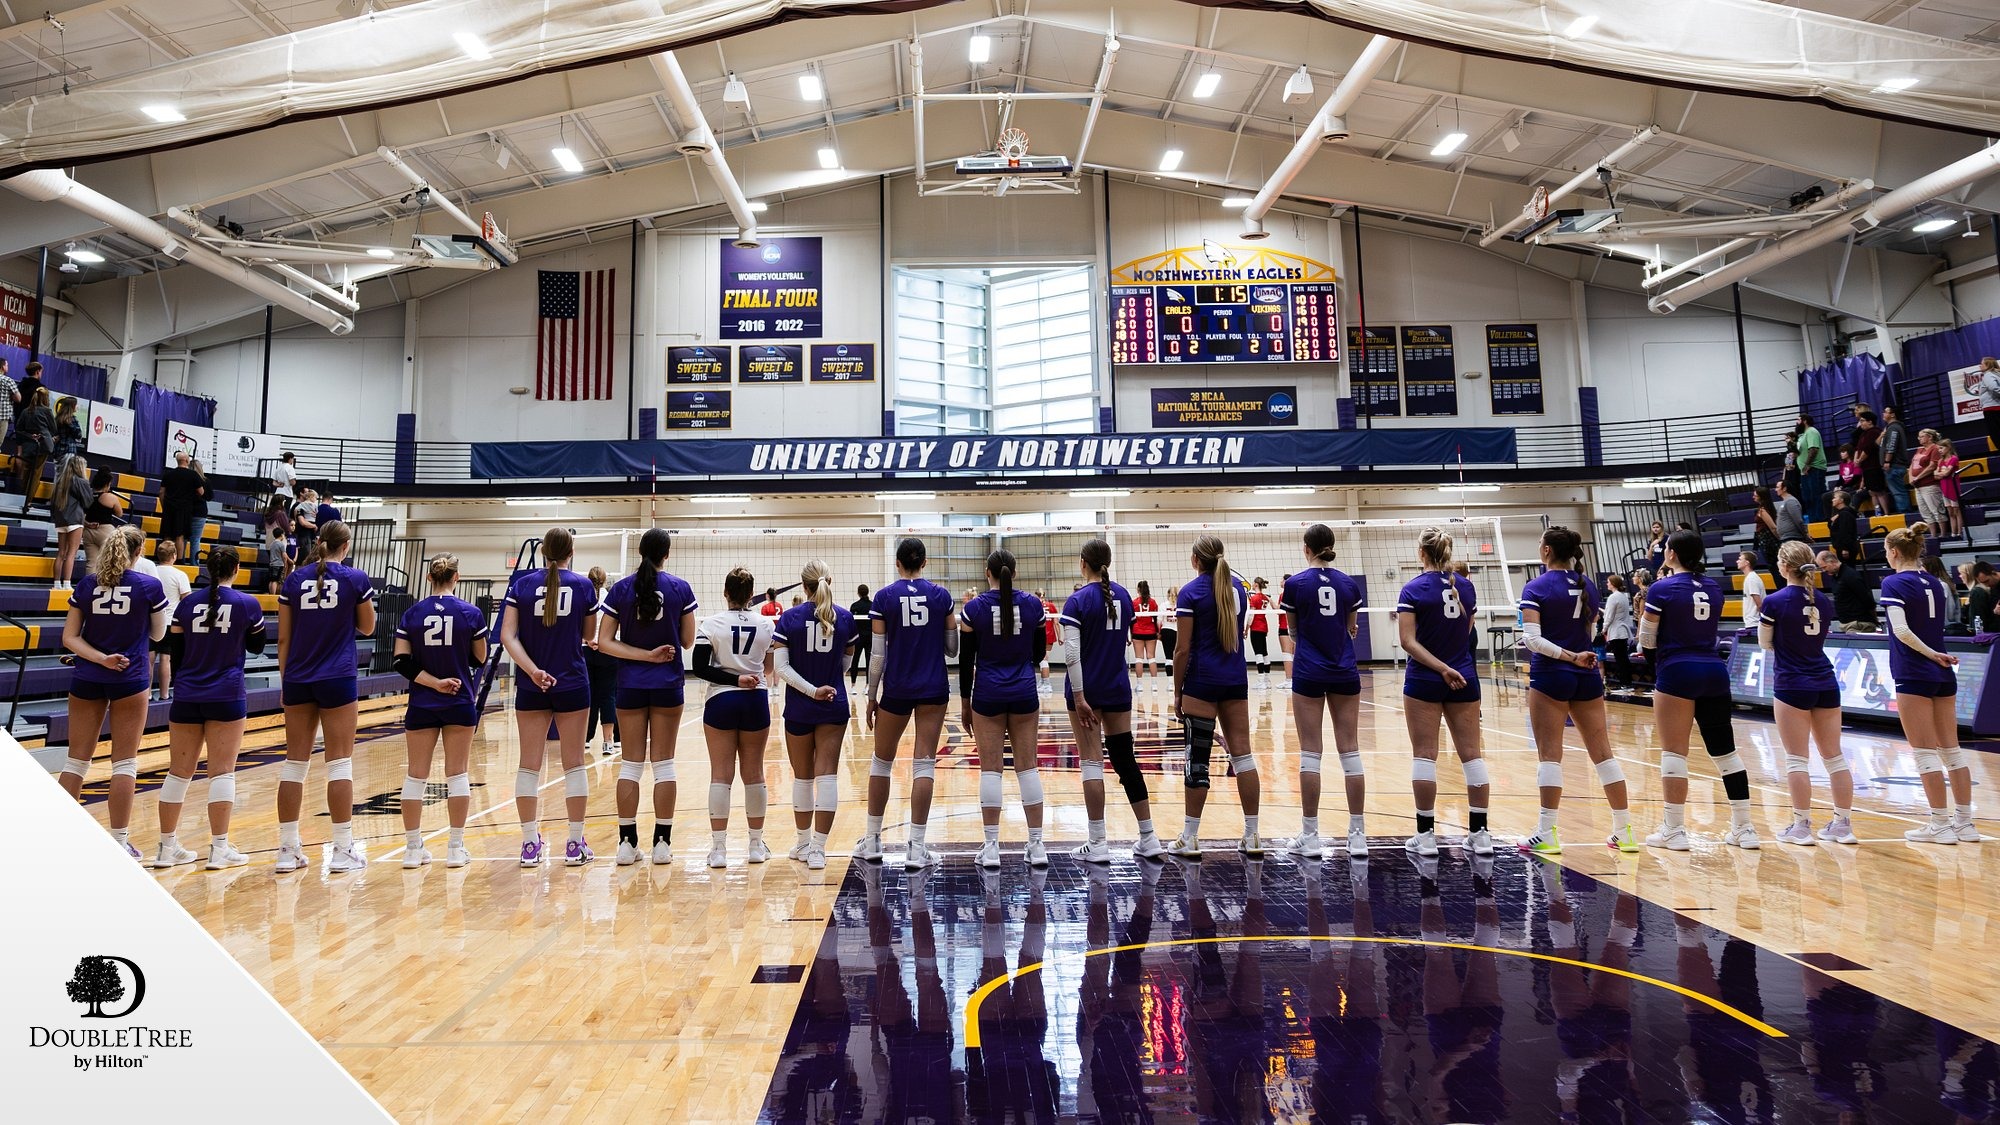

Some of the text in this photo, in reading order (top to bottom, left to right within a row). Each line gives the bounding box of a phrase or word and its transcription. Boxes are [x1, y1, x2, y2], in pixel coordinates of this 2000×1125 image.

[738, 272, 805, 281] WOMEN'S VOLLEYBALL
[1134, 268, 1302, 281] NORTHWESTERN EAGLES
[723, 288, 818, 308] FINAL FOUR
[1255, 286, 1282, 298] UMAC
[3, 294, 27, 317] NCCAA
[1121, 297, 1152, 307] 1 0 0
[1296, 294, 1334, 305] 10 0 0
[1118, 307, 1153, 319] 6 0 0
[1165, 306, 1192, 315] EAGLES
[1251, 305, 1281, 313] VIKINGS
[1296, 305, 1334, 316] 16 0 0
[738, 319, 804, 332] 2016 2022
[1115, 319, 1153, 329] 15 0 0
[1181, 316, 1192, 333] 0
[1223, 317, 1229, 330] 1
[1271, 314, 1282, 332] 0
[1297, 316, 1335, 327] 19 0 0
[1116, 330, 1153, 340] 18 0 0
[1294, 327, 1336, 337] 21 0 0
[1490, 330, 1528, 339] VOLLEYBALL
[1113, 341, 1154, 352] 21 0 0
[1170, 340, 1179, 354] 0
[1189, 340, 1199, 354] 2
[1250, 339, 1259, 353] 2
[1273, 339, 1283, 353] 0
[1295, 338, 1336, 349] 22 0 0
[1113, 352, 1155, 363] 23 0 0
[1295, 349, 1337, 360] 23 0 0
[677, 362, 723, 374] SWEET 16
[748, 361, 794, 372] SWEET 16
[821, 362, 864, 373] SWEET 16
[1190, 392, 1225, 402] 38 NCAA
[1158, 401, 1263, 412] NATIONAL TOURNAMENT
[1270, 405, 1293, 413] NCAA
[669, 410, 730, 419] REGIONAL RUNNER-UP
[1179, 412, 1243, 422] APPEARANCES
[105, 423, 118, 434] KTIS
[749, 437, 1245, 471] UNIVERSITY OF NORTHWESTERN
[91, 586, 132, 615] 25
[300, 579, 339, 610] 23
[534, 586, 573, 617] 20
[1318, 586, 1337, 616] 9
[1442, 589, 1461, 619] 8
[1568, 589, 1583, 619] 7
[1692, 592, 1711, 621] 6
[1924, 589, 1936, 618] 1
[899, 596, 929, 627] 15
[192, 603, 232, 634] 24
[1802, 606, 1821, 636] 3
[424, 615, 453, 646] 21
[731, 626, 757, 655] 17
